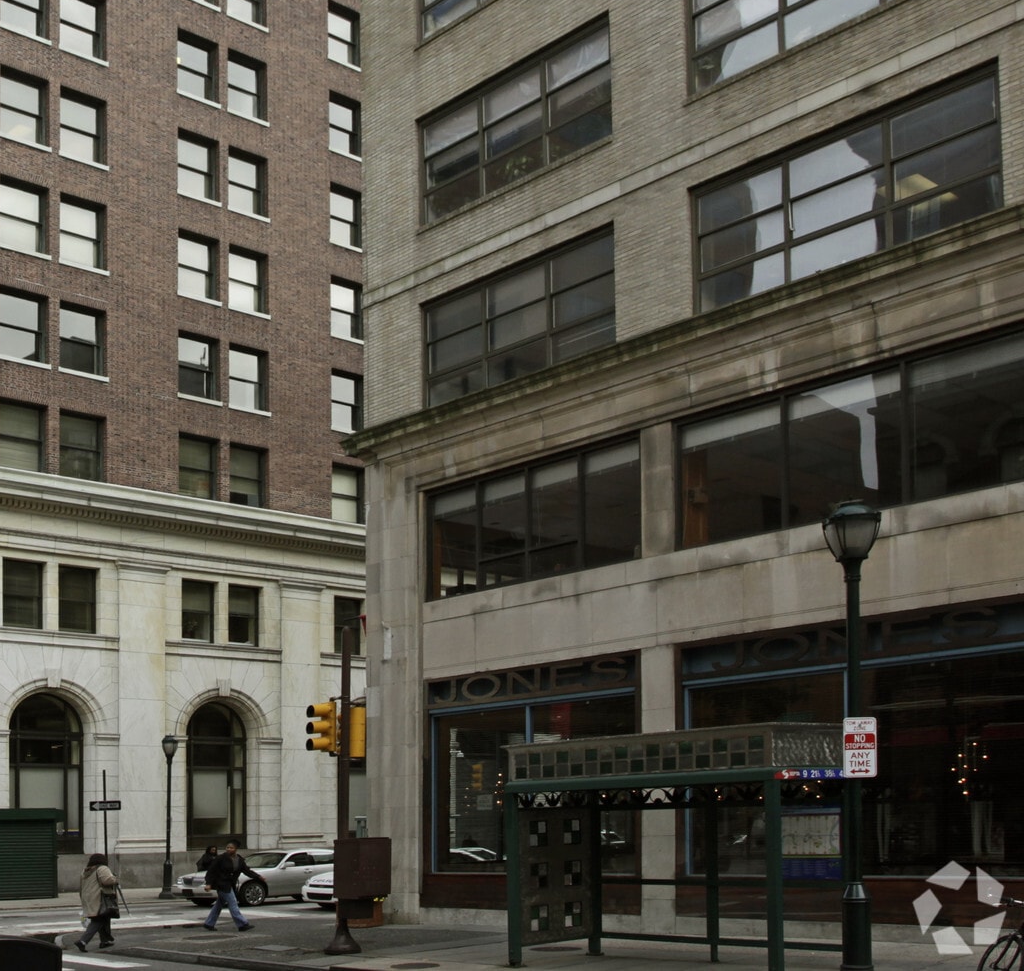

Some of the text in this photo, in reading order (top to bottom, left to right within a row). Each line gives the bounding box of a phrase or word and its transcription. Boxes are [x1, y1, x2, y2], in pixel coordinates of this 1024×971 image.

[712, 605, 999, 669] JONES
[434, 656, 627, 703] JONES
[854, 734, 866, 743] NO
[845, 742, 875, 750] STOPPING
[850, 751, 870, 759] ANY
[849, 760, 871, 768] TIME
[802, 769, 808, 778] 9
